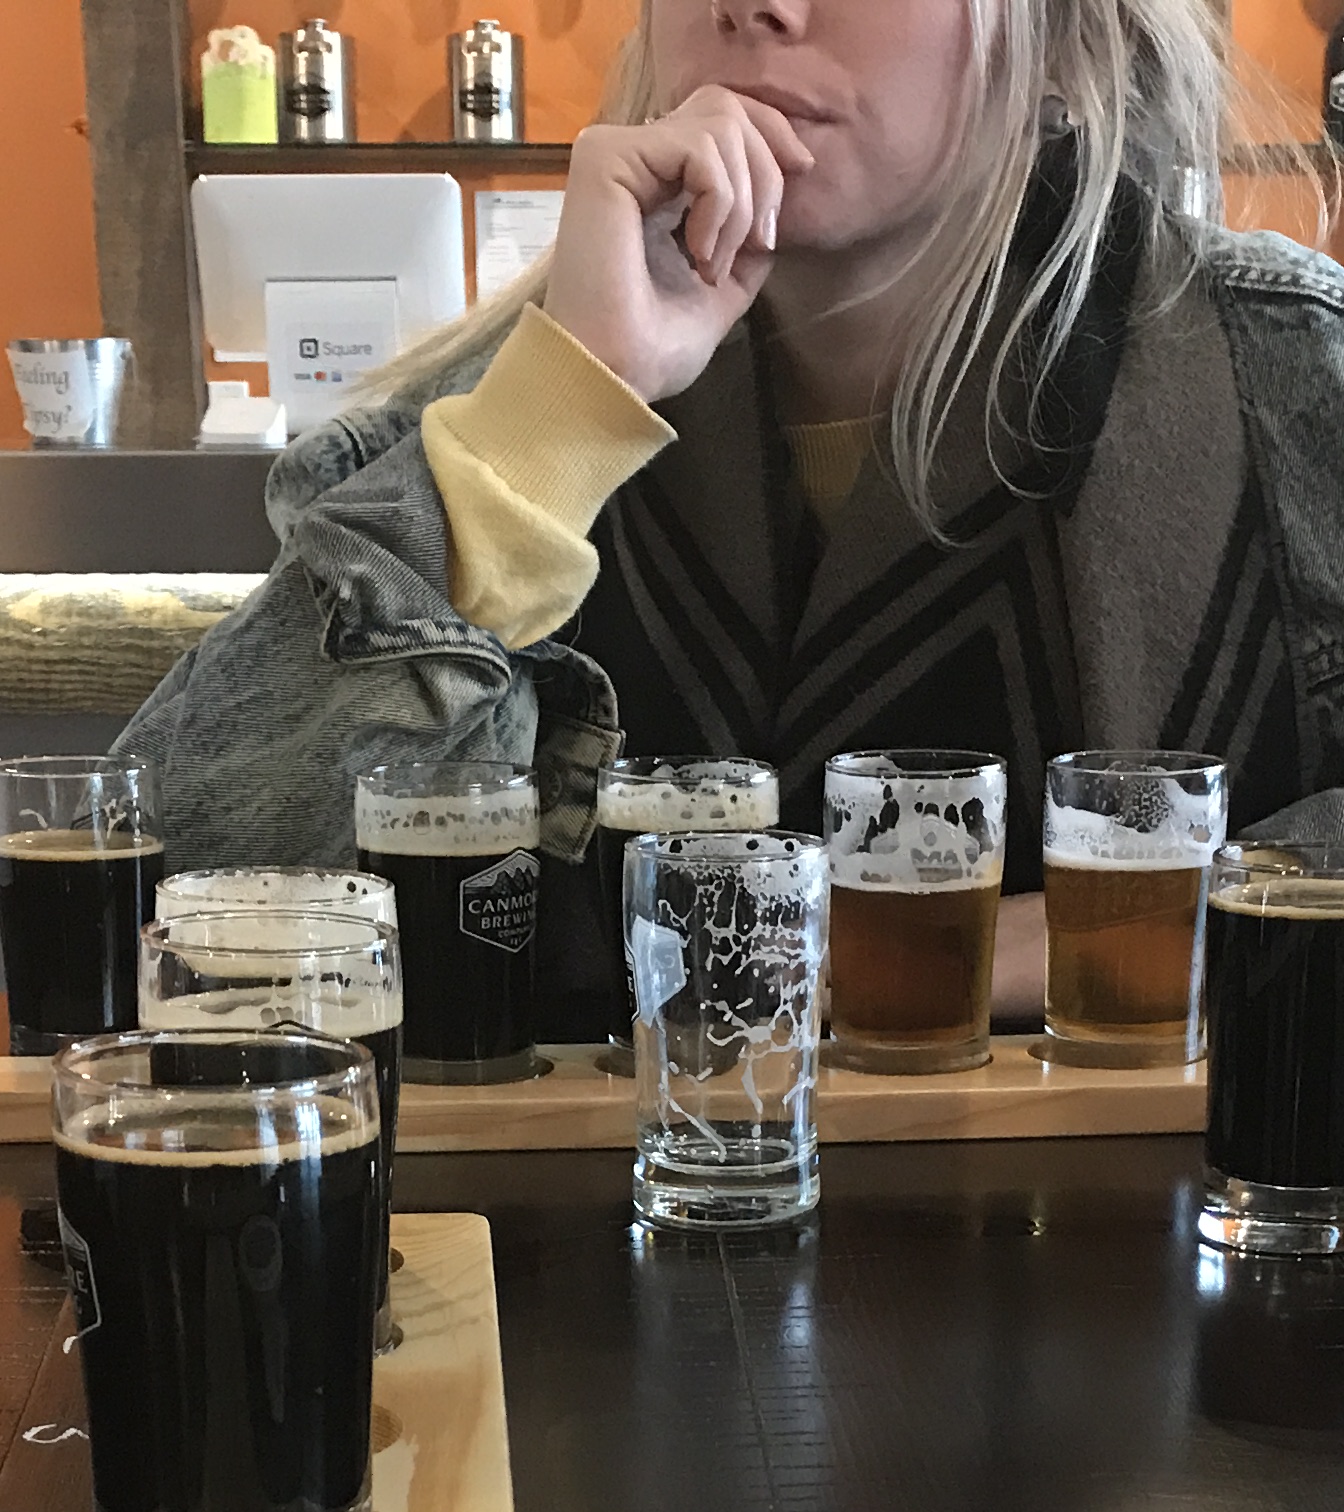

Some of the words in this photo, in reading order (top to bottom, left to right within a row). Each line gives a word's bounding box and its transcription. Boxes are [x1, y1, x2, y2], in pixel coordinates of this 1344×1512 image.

[323, 341, 373, 357] Square
[468, 891, 536, 914] CANMO
[481, 910, 535, 930] BREWIN
